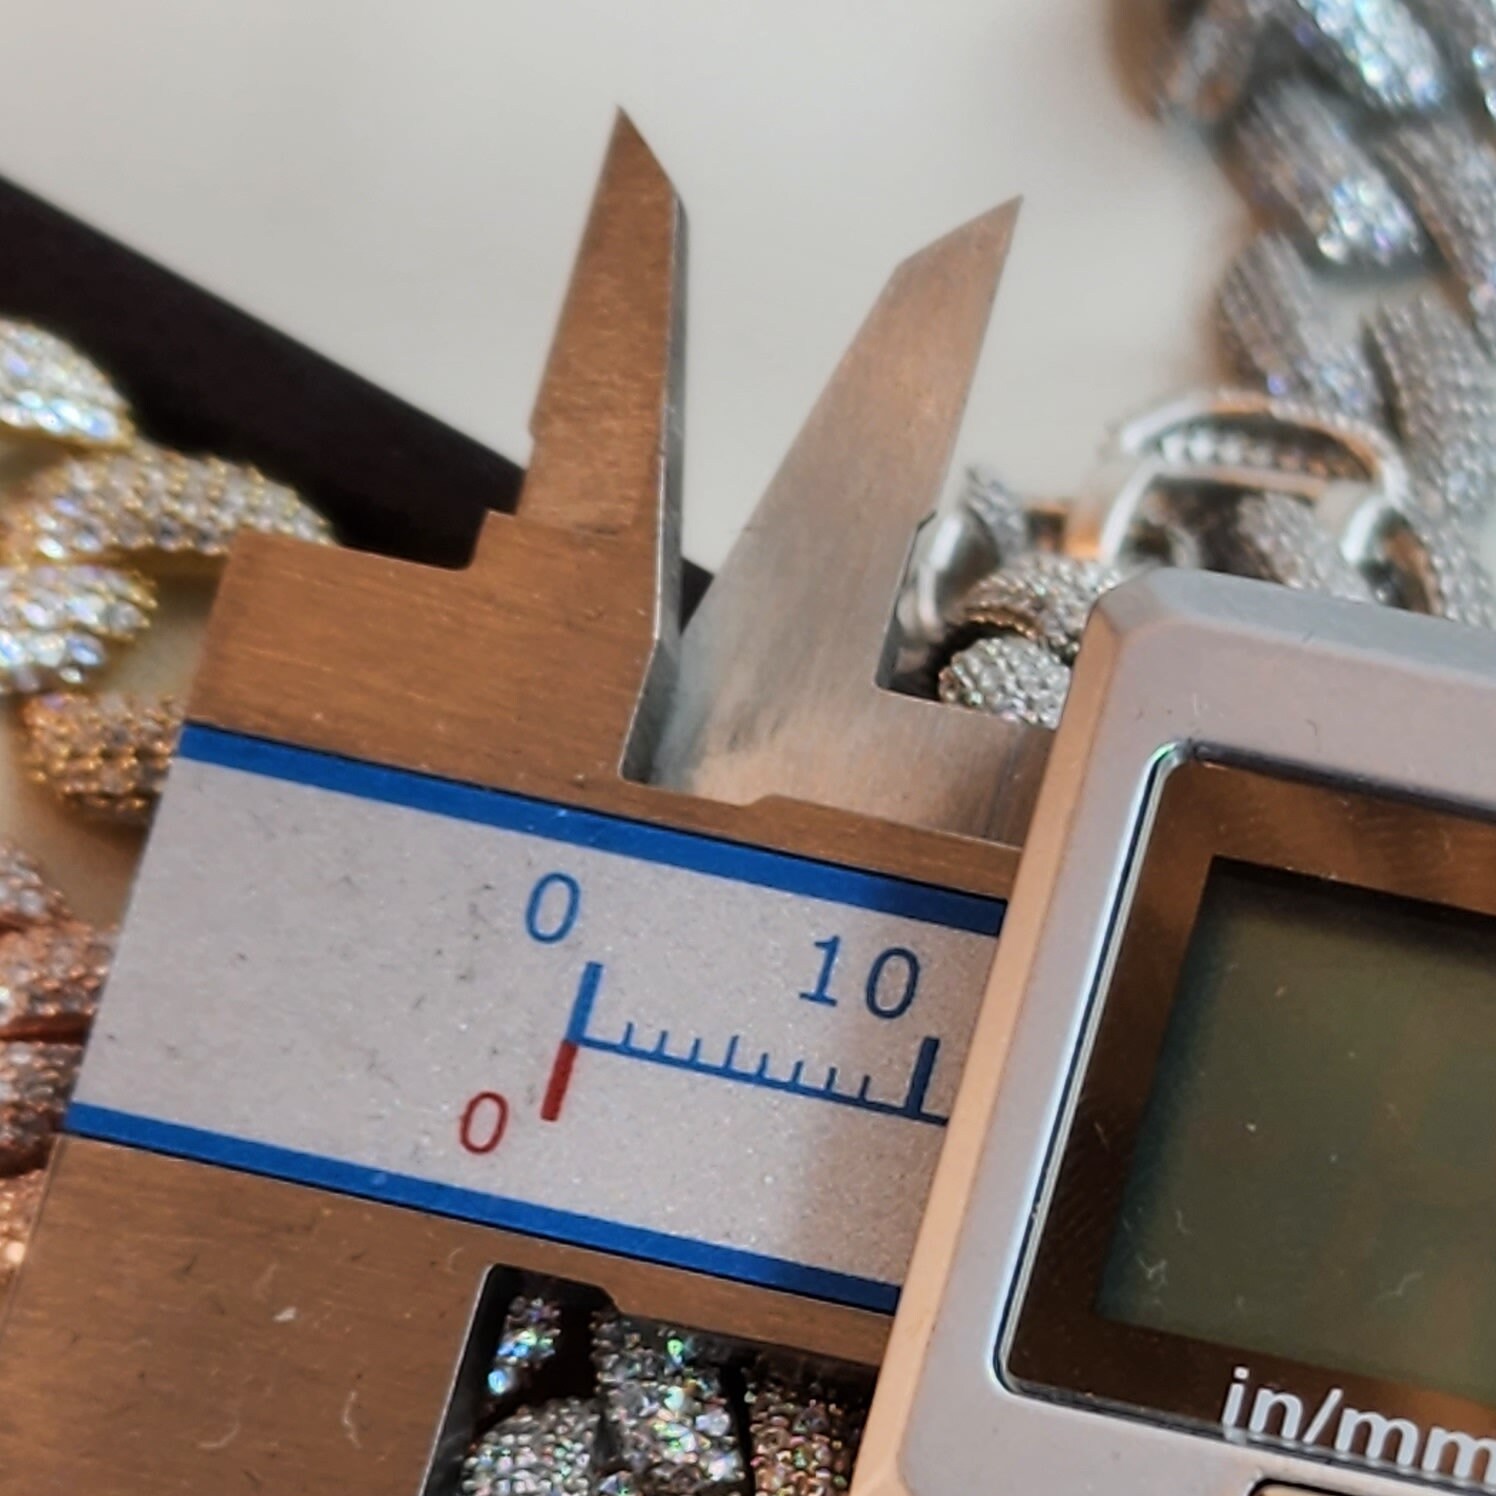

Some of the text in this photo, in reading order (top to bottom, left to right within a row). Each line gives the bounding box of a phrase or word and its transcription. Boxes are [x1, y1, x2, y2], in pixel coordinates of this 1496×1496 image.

[525, 873, 921, 1019] 0 10
[459, 1091, 509, 1154] 0
